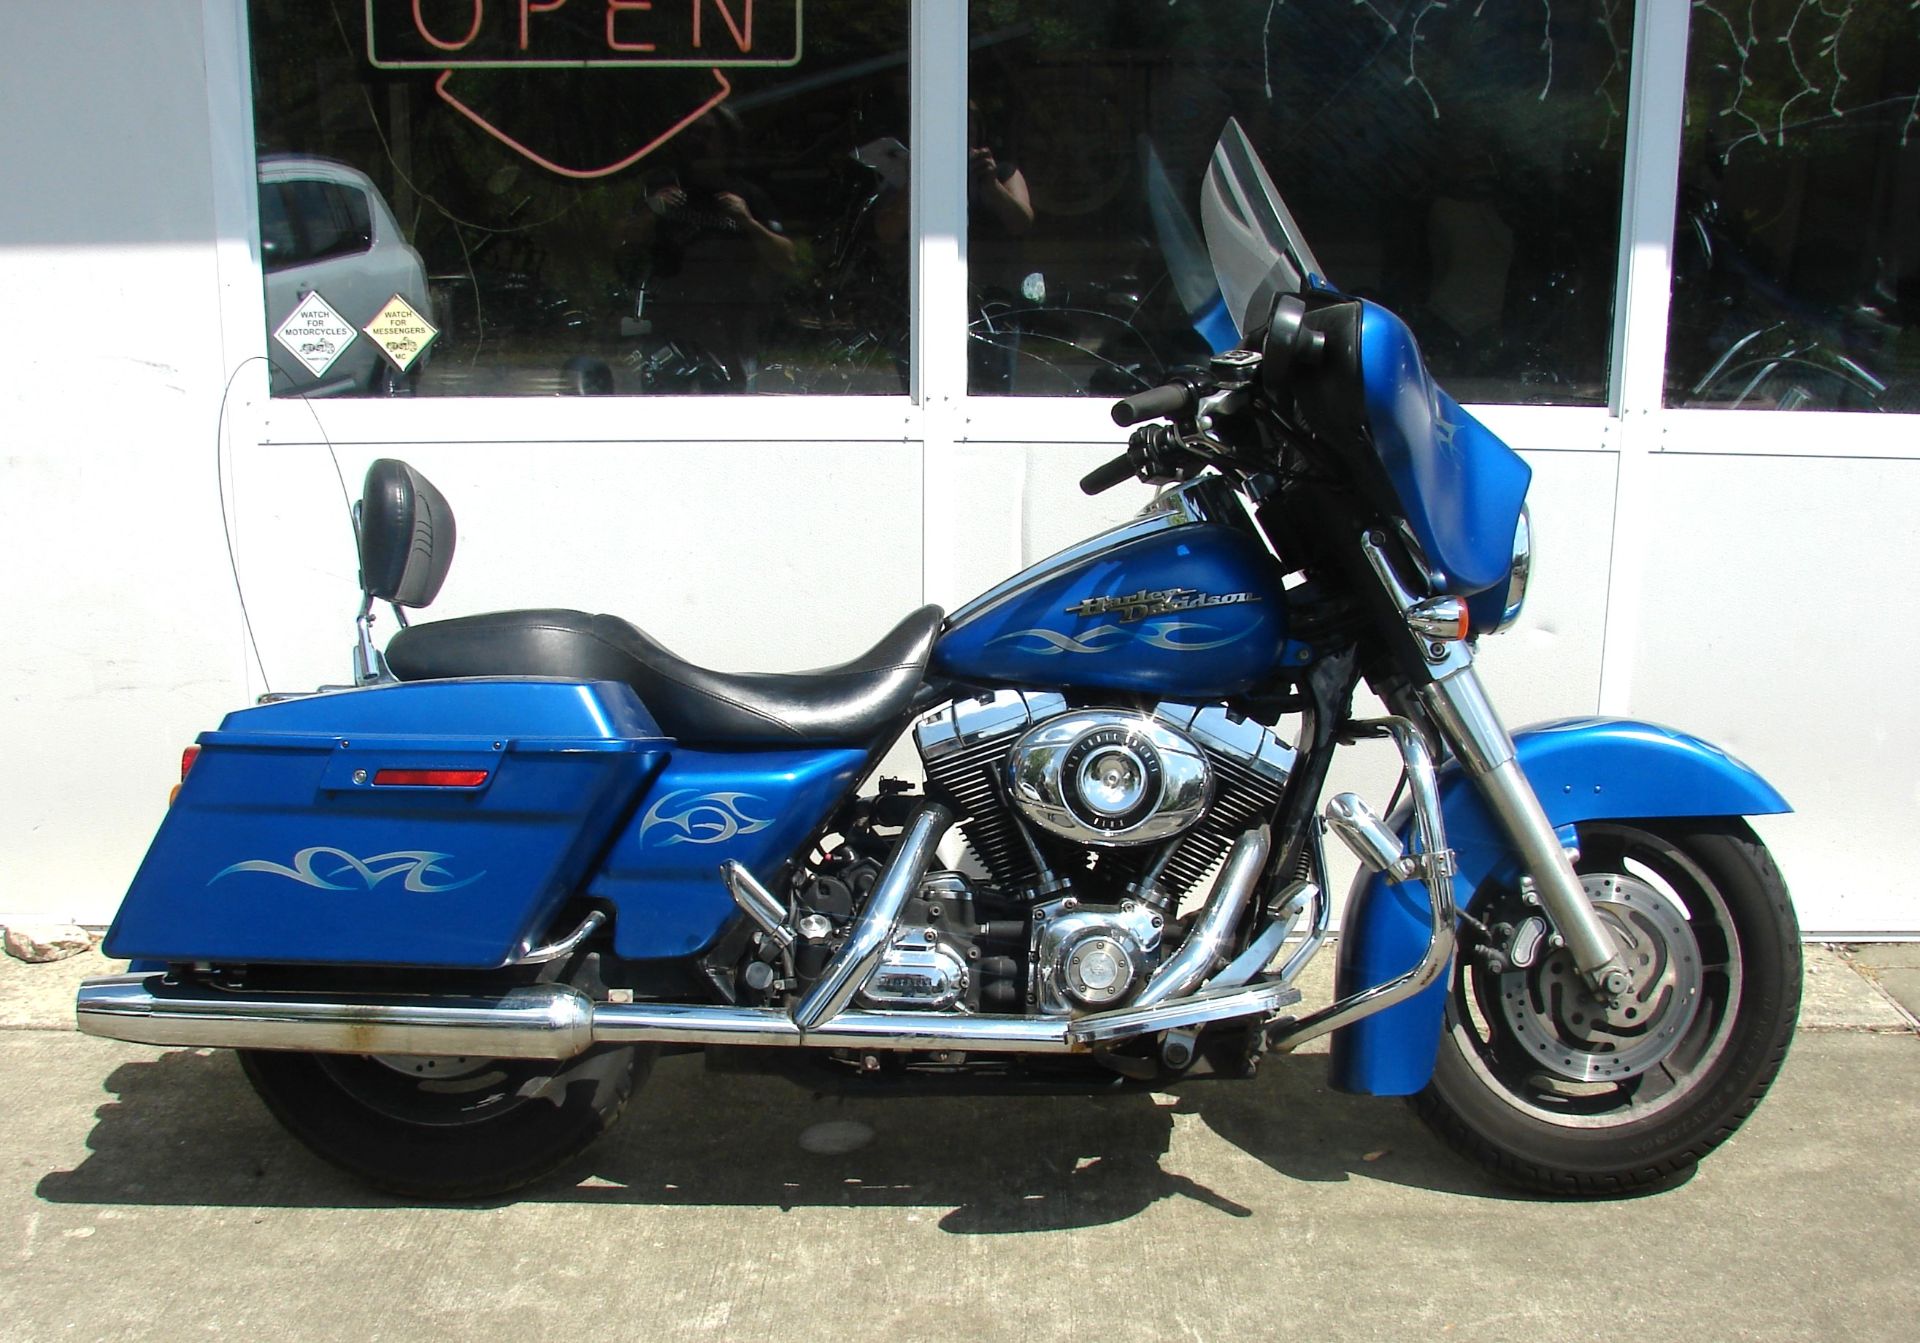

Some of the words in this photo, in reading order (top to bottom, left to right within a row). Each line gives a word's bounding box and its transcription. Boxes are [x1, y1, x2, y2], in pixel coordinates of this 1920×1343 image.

[412, 0, 754, 53] OPEN
[300, 311, 330, 319] WATCH
[285, 328, 347, 336] MOTORCYCLES
[373, 327, 426, 335] MESSENGERS
